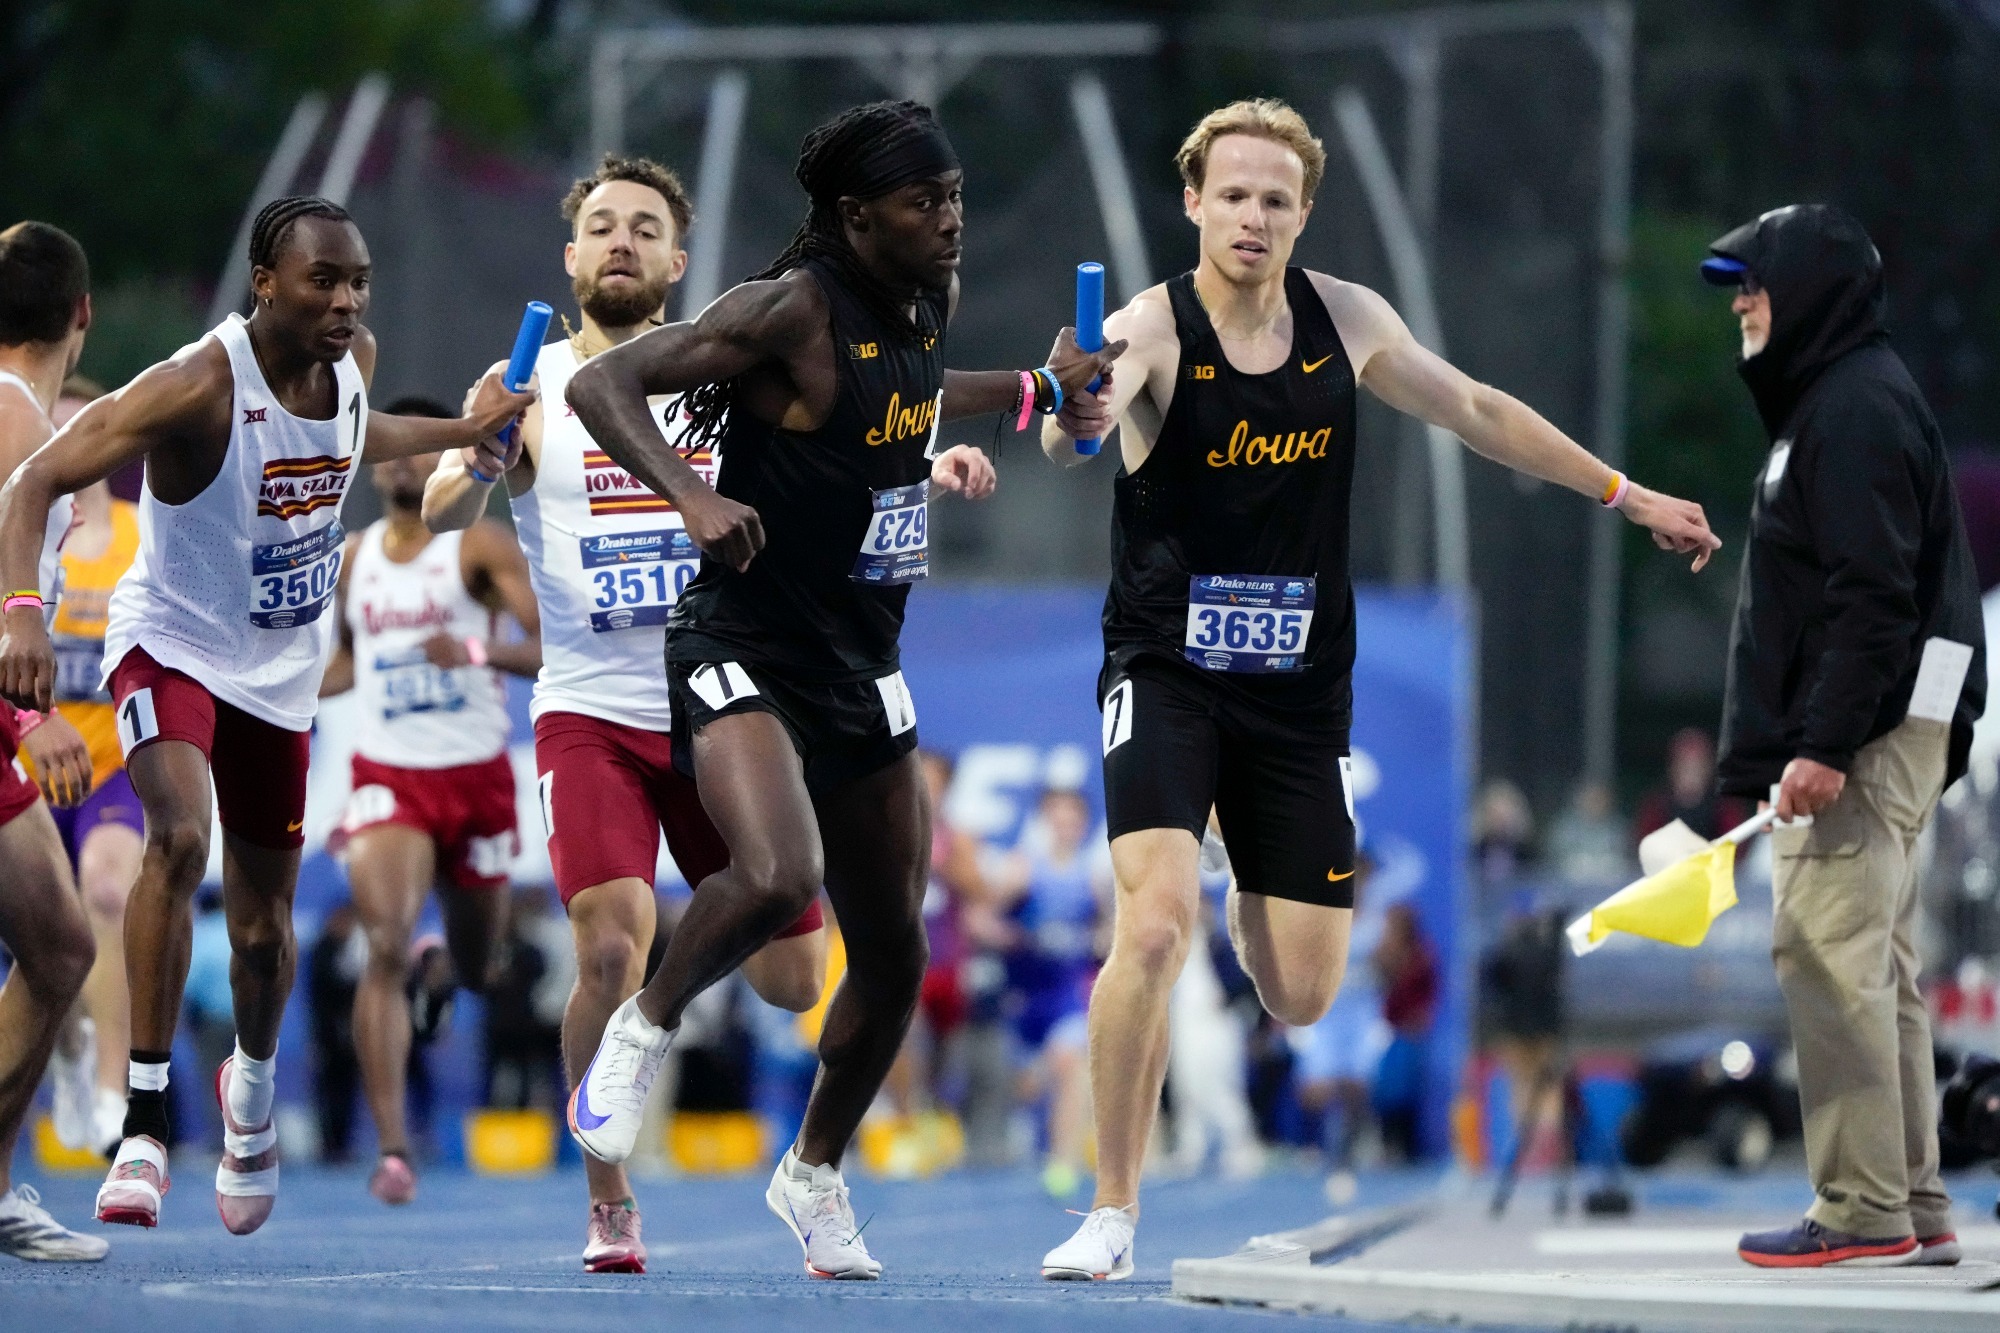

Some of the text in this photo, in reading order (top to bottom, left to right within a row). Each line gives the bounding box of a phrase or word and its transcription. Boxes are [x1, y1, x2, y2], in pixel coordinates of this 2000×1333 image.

[866, 392, 938, 446] Iow
[1207, 420, 1332, 468] Iowa
[259, 474, 348, 500] IOWA STATE
[585, 473, 641, 492] IOWA
[271, 543, 302, 558] Drake
[598, 536, 662, 550] Drake RELAYS
[259, 551, 341, 610] 3502
[593, 564, 696, 608] 3510
[1209, 576, 1246, 588] Drake
[1246, 581, 1275, 591] RELAYS
[1195, 609, 1303, 651] 3635
[123, 696, 143, 743] 1
